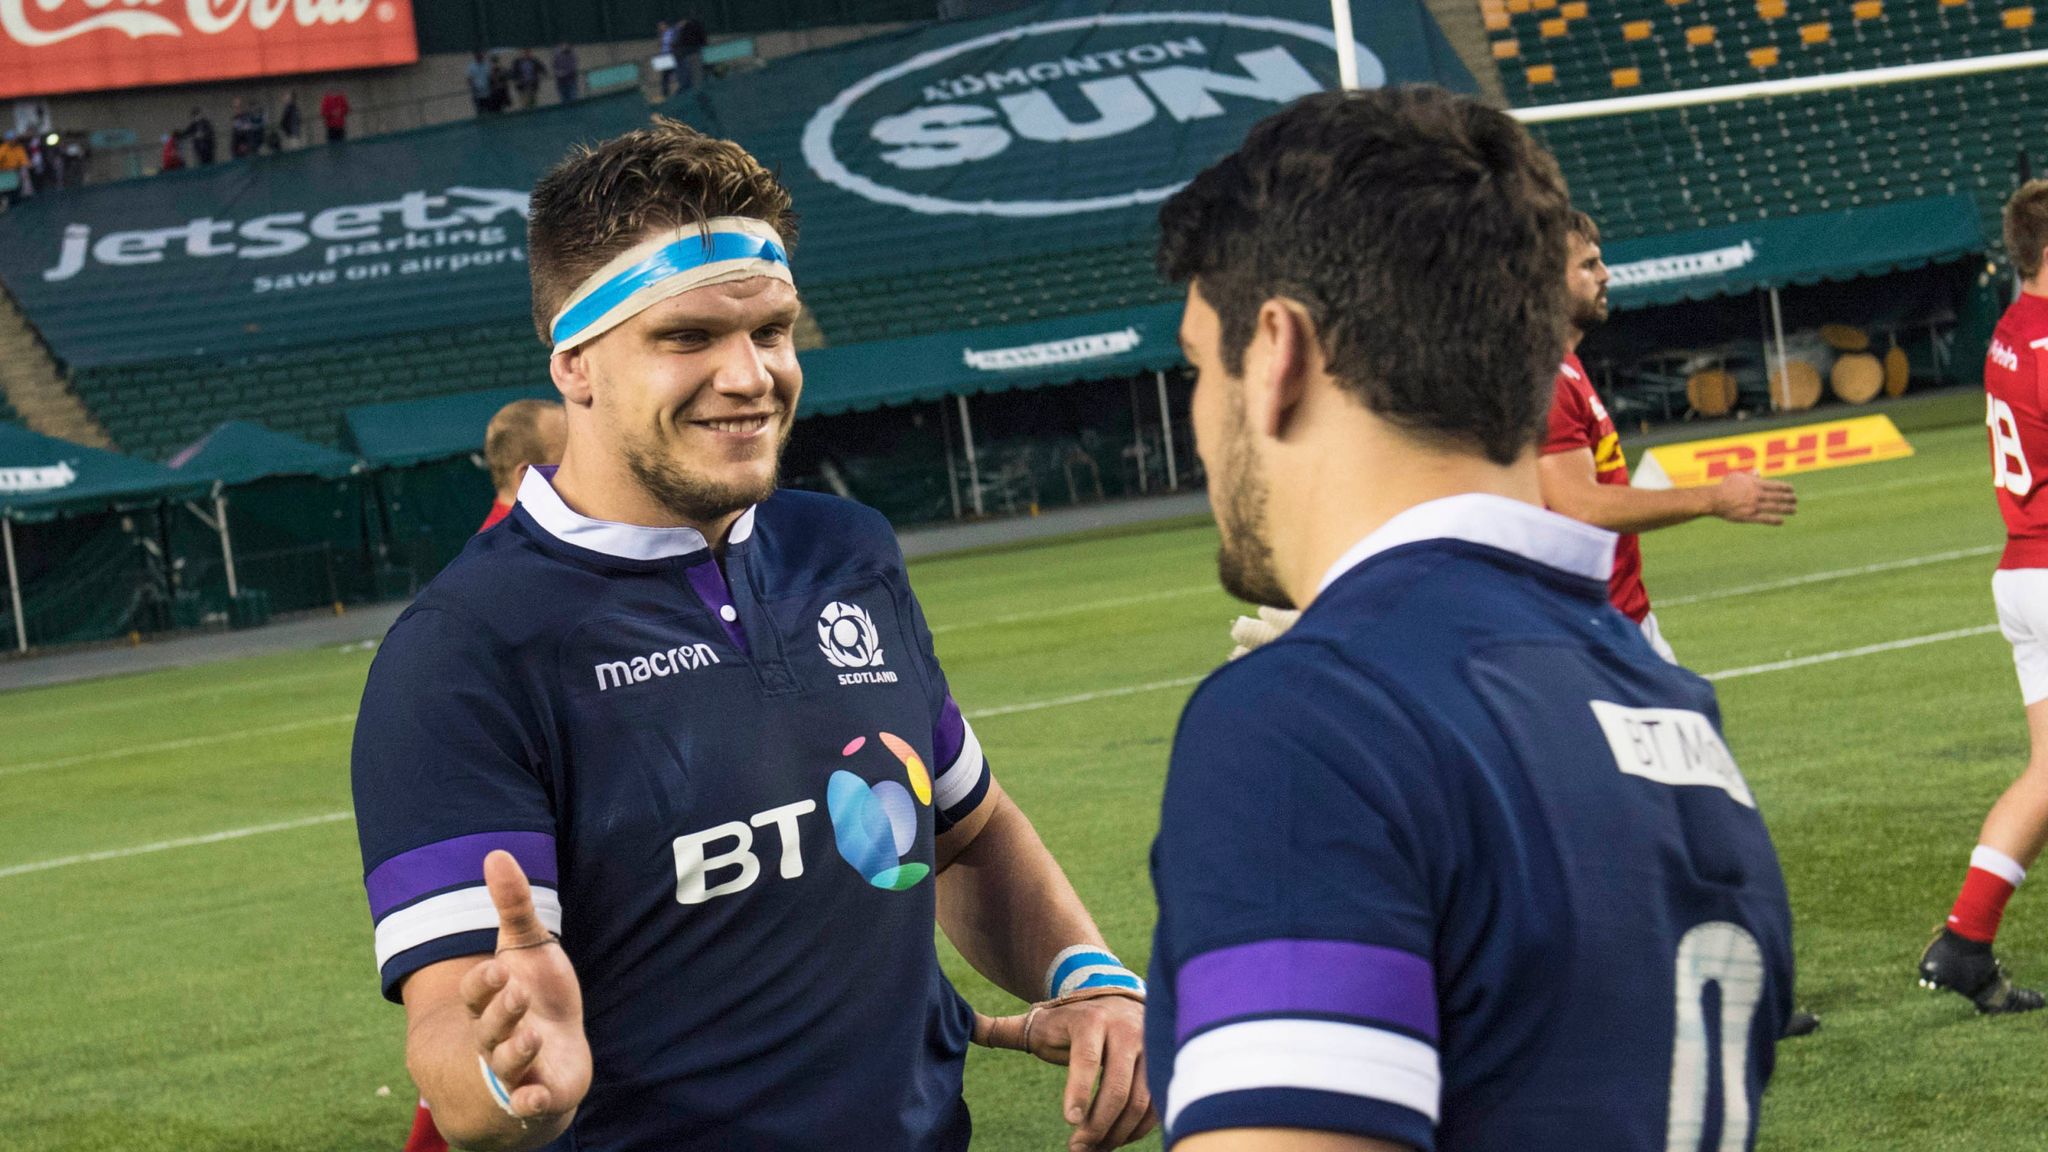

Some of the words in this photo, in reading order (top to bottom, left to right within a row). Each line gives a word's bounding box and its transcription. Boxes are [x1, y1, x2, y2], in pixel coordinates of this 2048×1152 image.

[870, 46, 1324, 170] SUN
[325, 226, 506, 265] parking
[1608, 243, 1746, 287] AWMILL
[344, 262, 391, 281] on
[1694, 429, 1873, 478] DHL
[594, 643, 720, 691] macron
[837, 671, 899, 685] SCOTLAND
[1623, 717, 1667, 771] BT
[672, 799, 817, 904] BT
